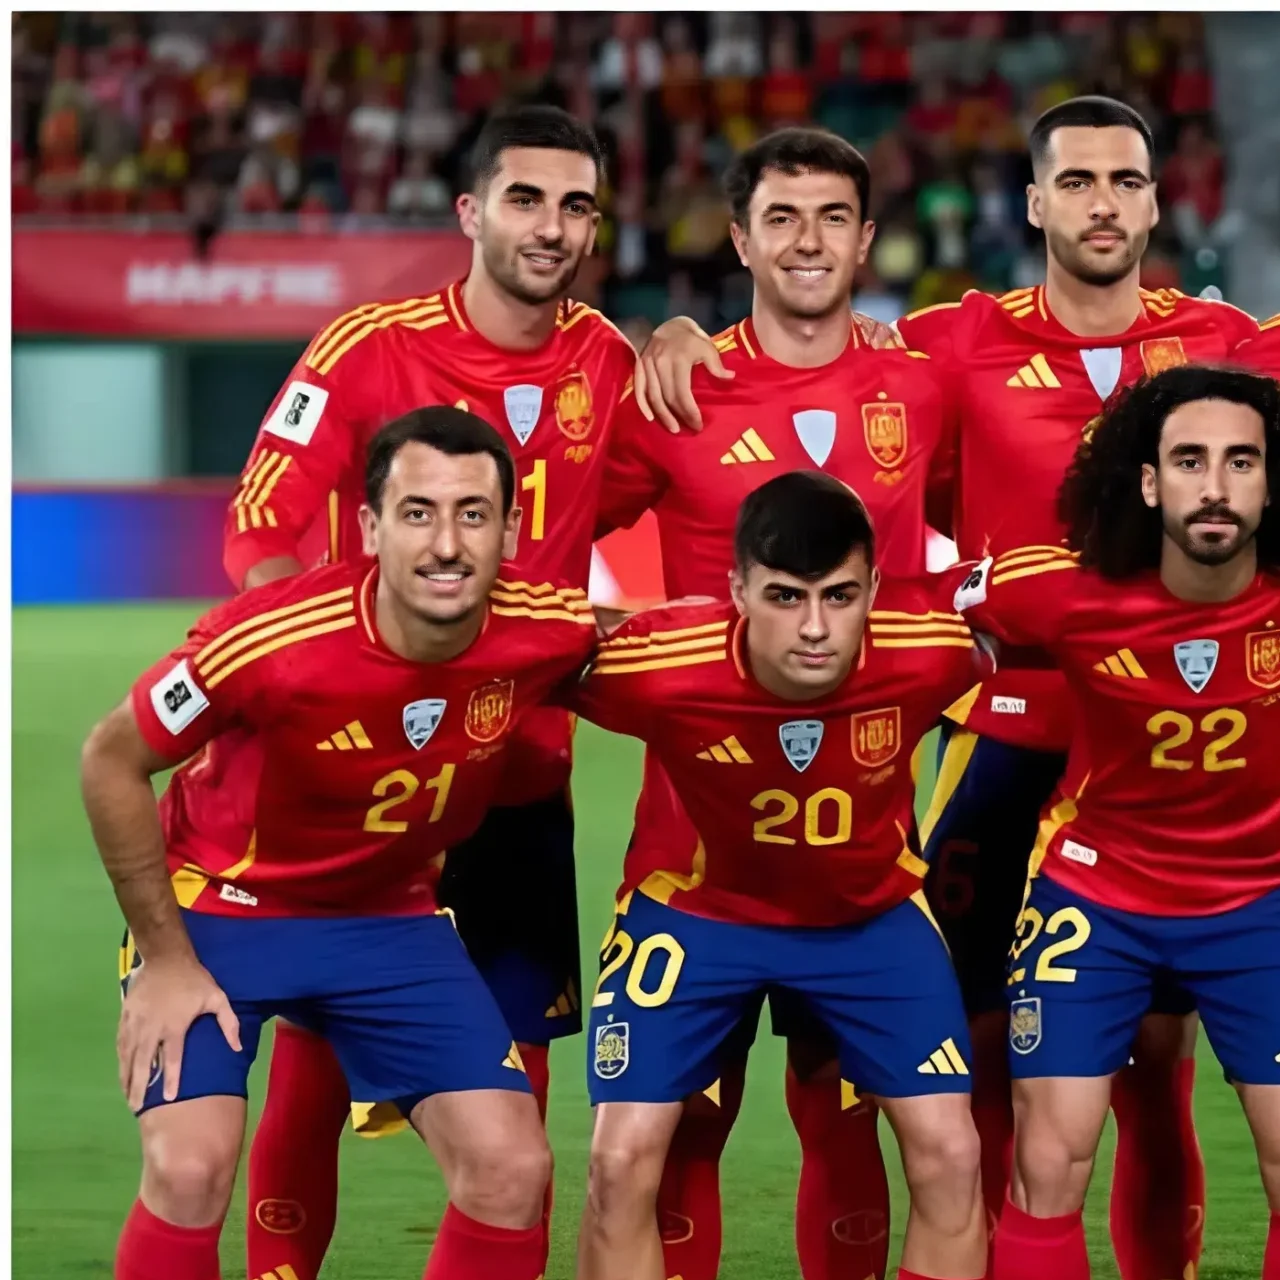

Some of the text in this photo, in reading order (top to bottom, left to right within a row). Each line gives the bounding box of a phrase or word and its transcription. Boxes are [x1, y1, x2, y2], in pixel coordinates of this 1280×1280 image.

[1146, 708, 1248, 772] 22
[363, 763, 456, 833] 21
[750, 787, 853, 846] 20
[591, 933, 686, 1008] 20
[1007, 906, 1091, 986] 22
